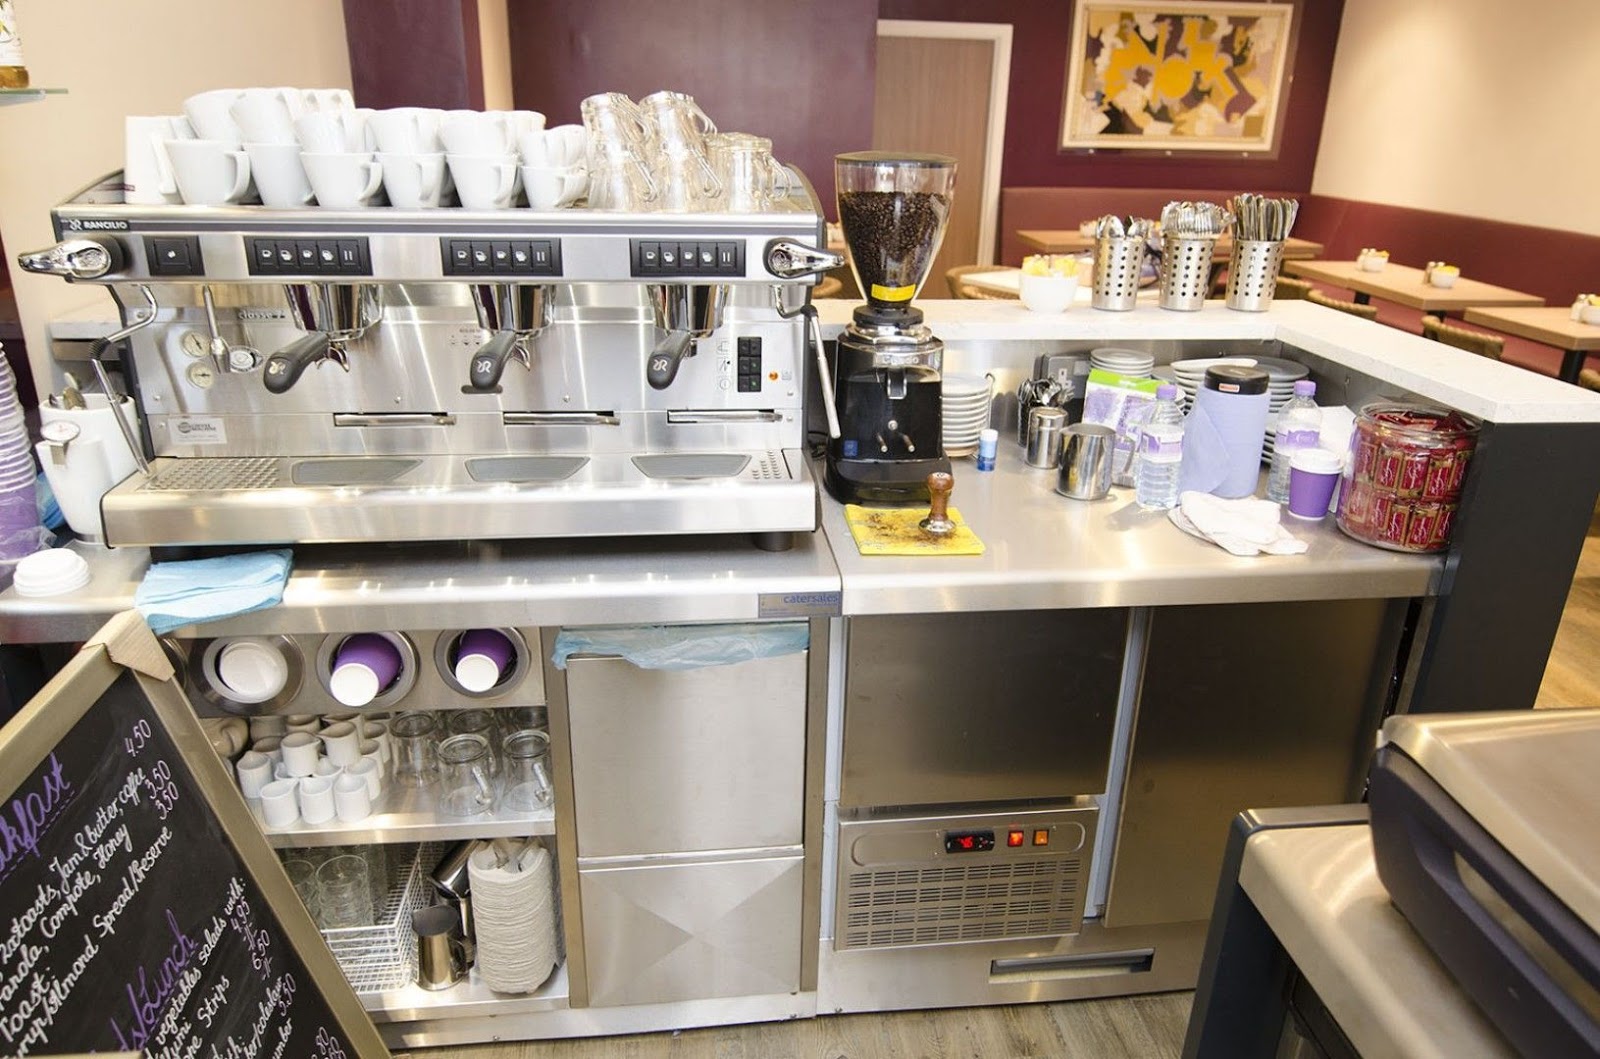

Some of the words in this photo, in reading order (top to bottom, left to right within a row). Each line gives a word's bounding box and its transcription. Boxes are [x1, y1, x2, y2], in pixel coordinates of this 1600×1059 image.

[83, 220, 128, 230] RANCILIO
[124, 719, 152, 757] 4.50
[145, 760, 171, 800] 3.50
[155, 781, 180, 820] 3.50
[0, 751, 71, 872] kfast
[49, 852, 81, 894] Jam
[85, 797, 125, 845] butter,
[0, 944, 49, 1012] ranola,
[40, 871, 101, 938] Compote,
[93, 823, 133, 869] Honey
[156, 967, 202, 1046] vegetables
[199, 916, 227, 966] salads
[224, 877, 246, 916] with:
[197, 975, 230, 1029] Strips
